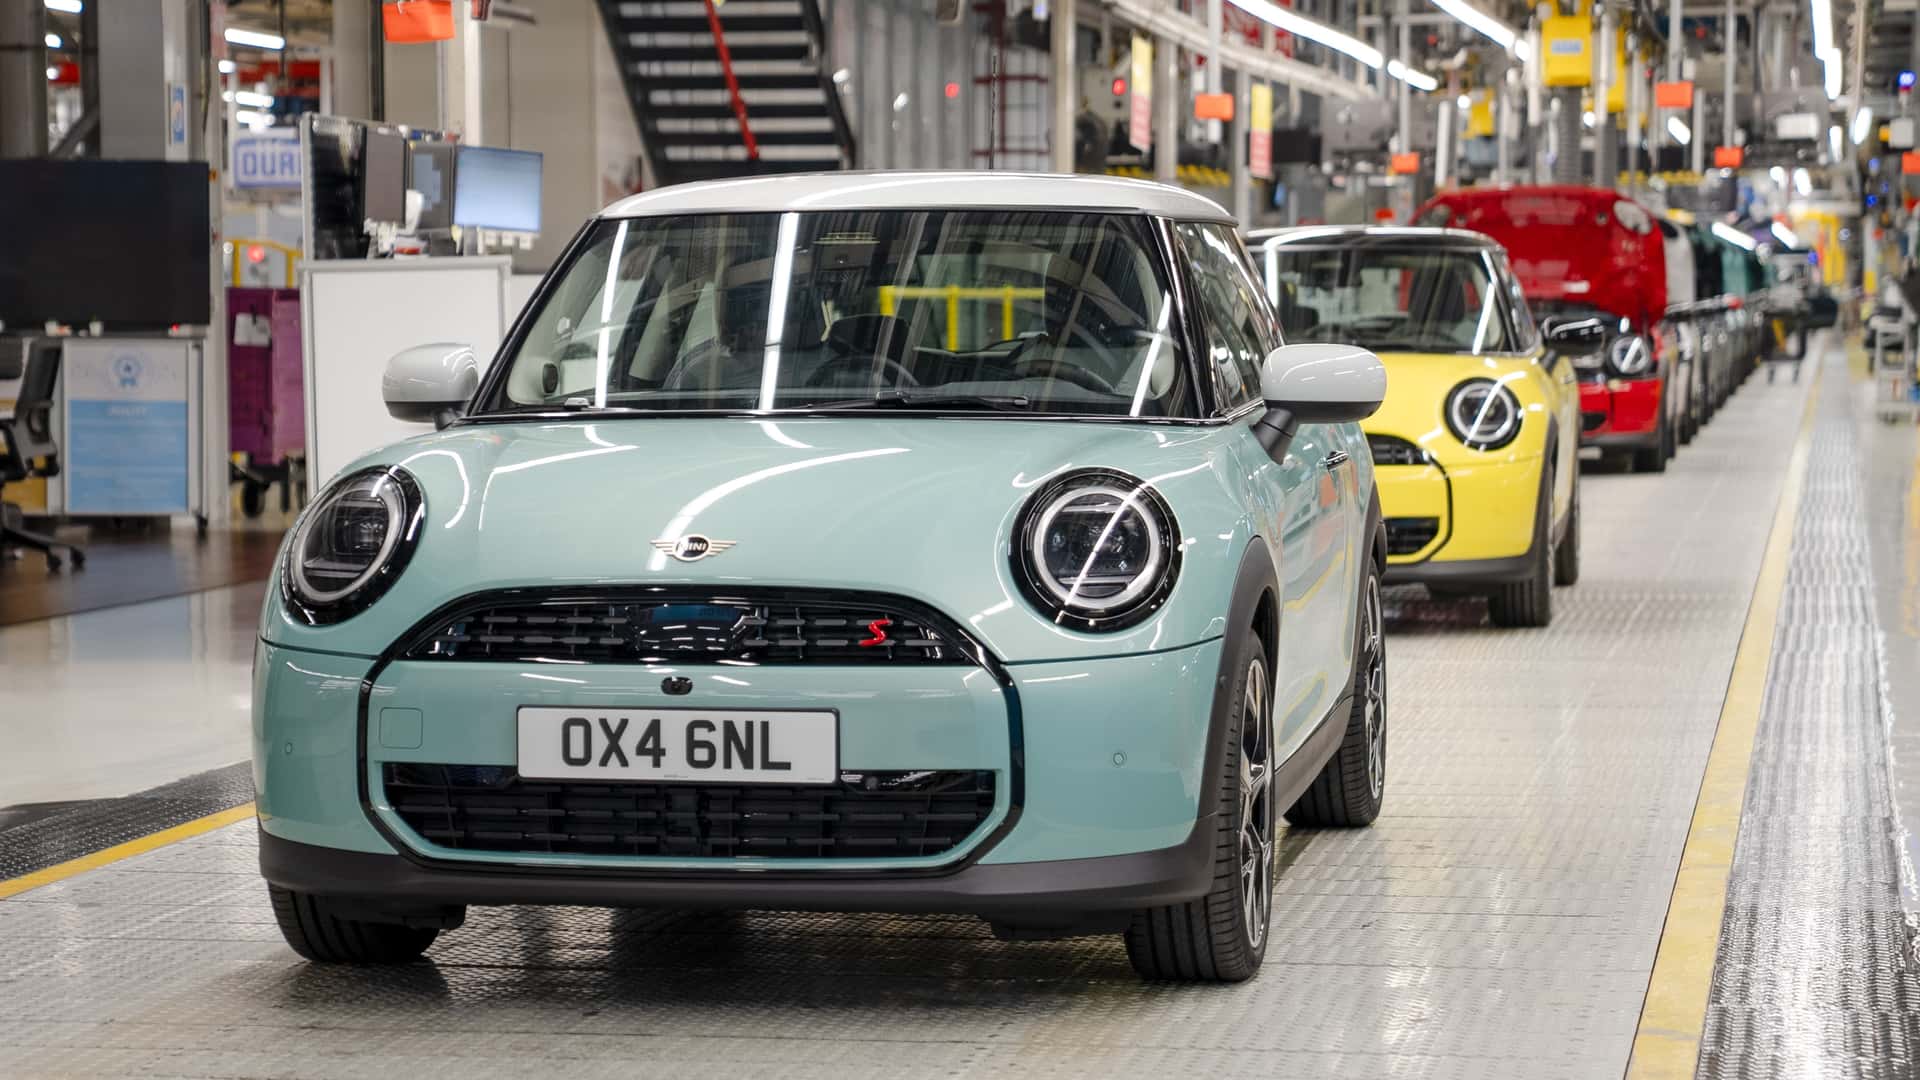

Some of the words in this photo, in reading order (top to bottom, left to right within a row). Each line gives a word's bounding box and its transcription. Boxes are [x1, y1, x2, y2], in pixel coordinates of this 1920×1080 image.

[858, 619, 891, 647] S
[561, 717, 667, 768] OX4
[685, 718, 792, 770] 6NL
